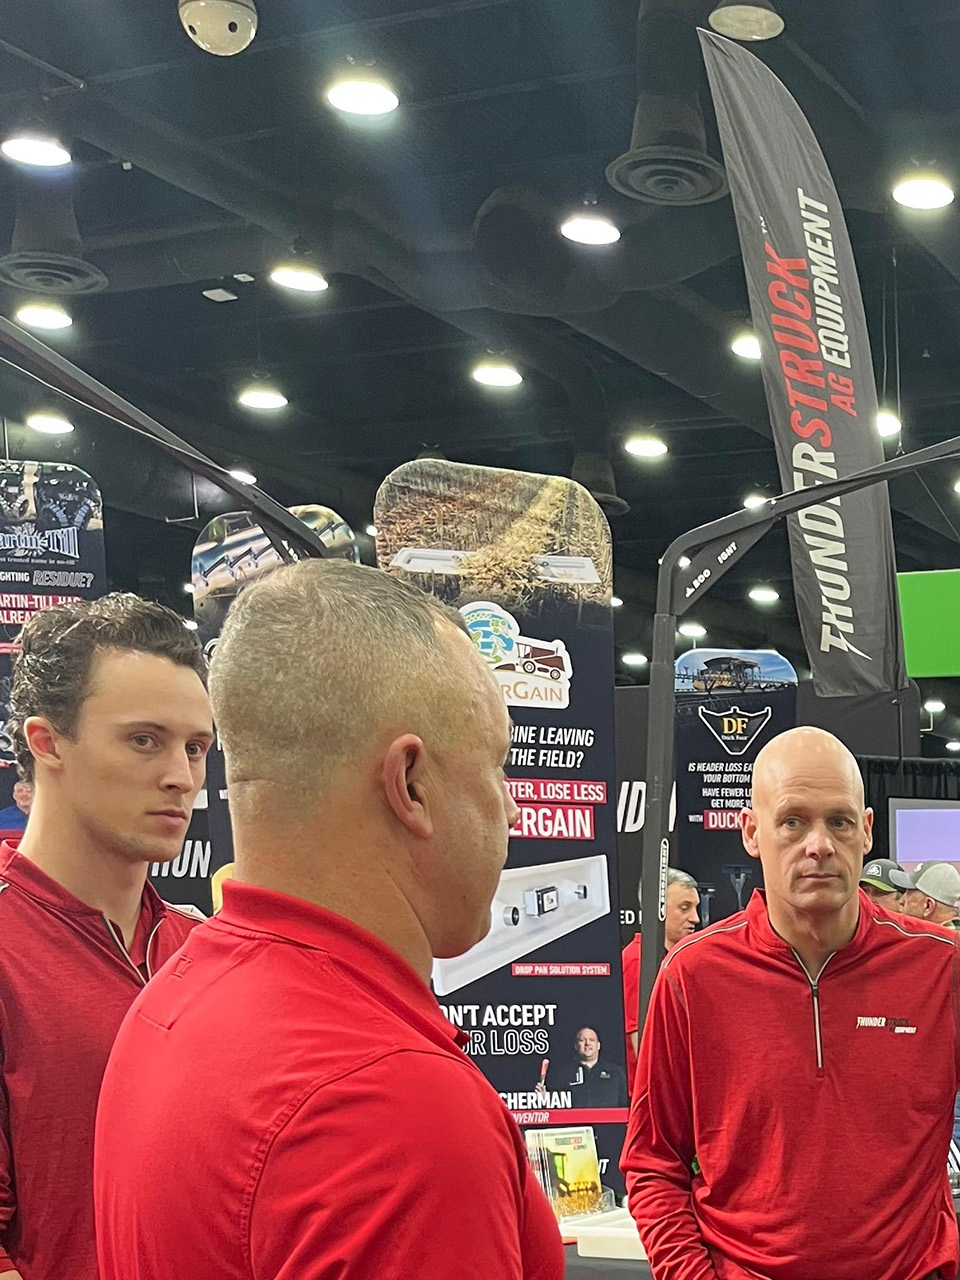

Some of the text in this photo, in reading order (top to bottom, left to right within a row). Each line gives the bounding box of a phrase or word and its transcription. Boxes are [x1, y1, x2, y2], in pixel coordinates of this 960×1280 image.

[797, 187, 858, 417] AG EQUIPMENT
[722, 717, 749, 734] DF
[539, 726, 595, 747] LEAVING
[510, 748, 584, 768] THE FIELD?
[697, 762, 725, 772] HEADER
[725, 763, 743, 772] LOSS
[703, 773, 722, 783] YOUR
[540, 782, 572, 800] LOSE
[573, 783, 604, 801] LESS
[711, 799, 724, 808] GET
[582, 965, 608, 975] SYSTEM
[482, 1004, 558, 1027] ACCEPT
[490, 1029, 550, 1055] LOSS
